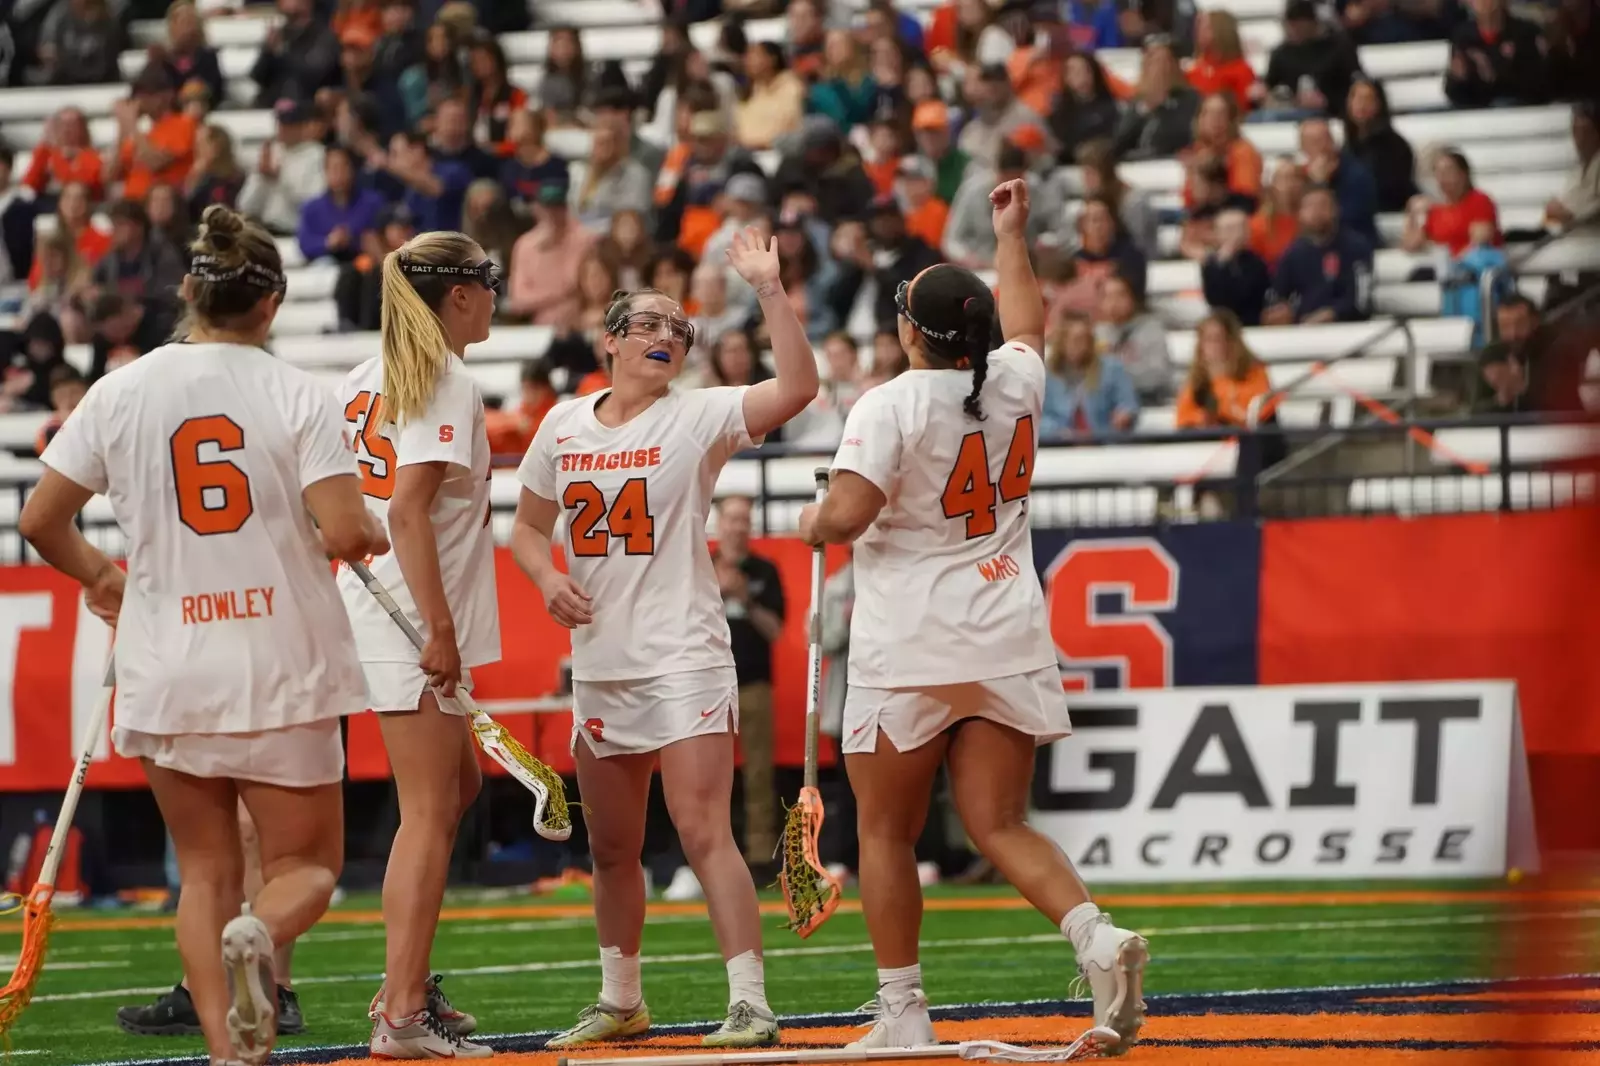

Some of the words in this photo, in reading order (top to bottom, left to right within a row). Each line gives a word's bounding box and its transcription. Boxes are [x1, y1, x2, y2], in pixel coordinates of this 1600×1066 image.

[411, 265, 432, 273] GAIT
[437, 266, 459, 274] GAIT
[920, 326, 945, 340] GAIT
[438, 424, 454, 442] S
[169, 413, 253, 536] 6
[561, 446, 661, 472] SYRACUSE
[940, 413, 1035, 540] 44
[562, 477, 654, 557] 24
[181, 587, 274, 624] ROWLEY
[1043, 536, 1180, 691] S
[76, 751, 92, 785] GAIT
[1031, 697, 1481, 812] GAIT
[1078, 828, 1472, 866] ACROSSE
